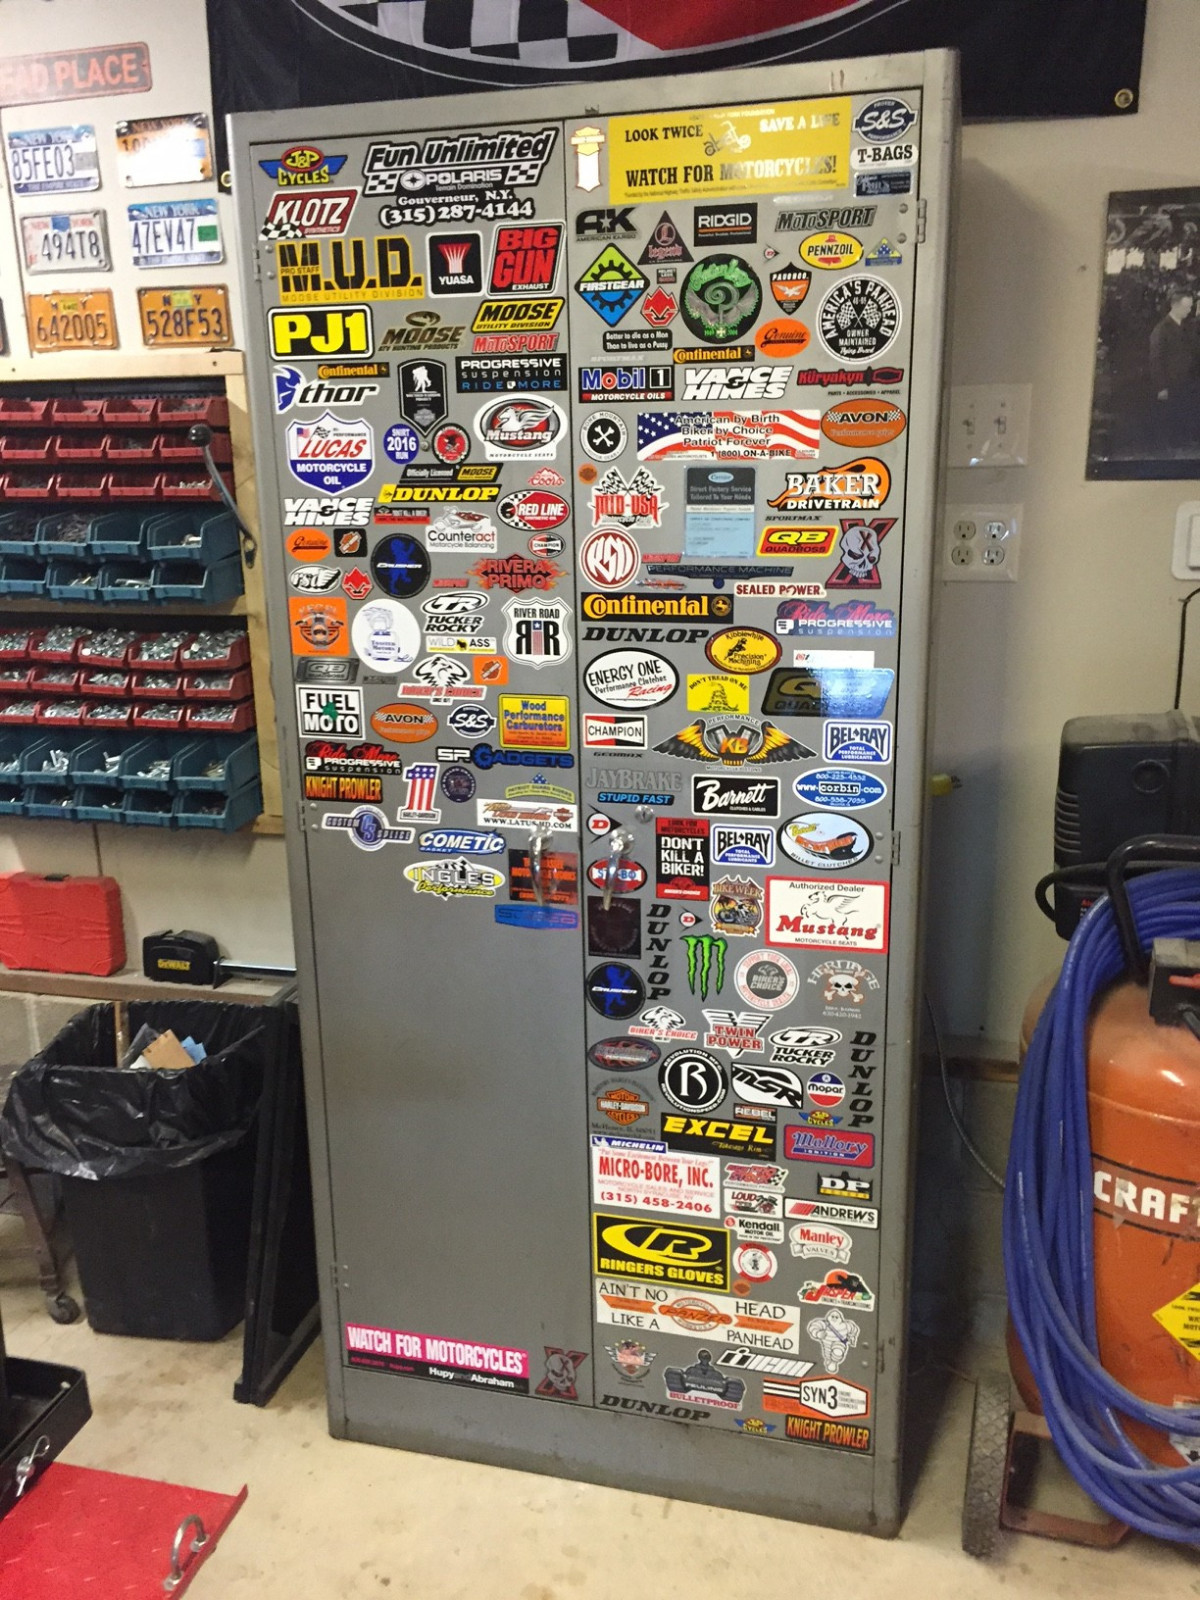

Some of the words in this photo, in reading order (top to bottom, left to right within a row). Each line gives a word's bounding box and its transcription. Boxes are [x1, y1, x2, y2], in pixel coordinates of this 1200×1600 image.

[54, 53, 138, 90] PLACE
[760, 117, 794, 132] SAVE
[861, 109, 907, 131] S&S
[625, 129, 659, 142] LOOK
[662, 125, 703, 139] TWICE
[368, 146, 416, 171] Fun
[424, 132, 552, 164] Unlimited
[858, 145, 913, 163] T-BAGS
[12, 144, 76, 181] 85FE03
[278, 165, 329, 186] CYCLES
[426, 169, 502, 185] POLARIS
[626, 167, 678, 187] WATCH
[684, 165, 714, 182] FOR
[719, 155, 837, 180] MOTORCYCLES!
[485, 190, 513, 201] N.Y.
[273, 197, 350, 226] KLOTZ
[698, 212, 752, 228] RIDGID
[132, 218, 195, 254] 47EV47
[498, 228, 558, 249] BIG
[42, 230, 100, 260] 494T8
[808, 244, 853, 257] PENNZOIL
[492, 249, 555, 288] GUN
[438, 275, 474, 286] YUASA
[512, 283, 549, 291] EXHAUST
[580, 280, 645, 292] FIRSTGEAR
[281, 294, 319, 302] MOOSE
[372, 288, 424, 299] DIVISION
[480, 303, 557, 322] MOOSE
[37, 314, 108, 342] 642005
[146, 307, 223, 337] 528F53
[476, 323, 508, 331] UTILITY
[510, 322, 551, 330] DIVISION
[274, 312, 367, 354] PJ1
[381, 326, 465, 345] MOOSE
[847, 329, 869, 338] OWNER
[839, 337, 876, 346] MAINTAINED
[674, 349, 741, 363] Continental
[318, 364, 378, 378] Continental
[461, 359, 561, 369] PROGRESSIVE
[462, 370, 561, 379] suspension
[582, 368, 645, 390] Mobil
[462, 381, 503, 390] RIDE
[518, 380, 561, 389] MORE
[299, 383, 377, 404] thor
[591, 393, 645, 401] MOTORCYCLE
[674, 415, 731, 425] American
[752, 413, 779, 423] Birth
[839, 412, 888, 423] AVON
[486, 429, 553, 444] Mustang
[682, 426, 713, 436] Biker
[733, 426, 772, 435] Choice
[298, 438, 367, 458] LUCAS
[387, 437, 417, 453] 2016
[683, 437, 722, 447] Patriot
[727, 437, 771, 446] Forever
[395, 451, 409, 461] RUN
[743, 449, 791, 458] ON-A-BIKE
[297, 463, 367, 473] MOTORCYCLE
[462, 468, 493, 476] MOOSE
[323, 476, 341, 485] OIL
[532, 476, 562, 487] Coors
[786, 473, 881, 497] BAKER
[393, 487, 499, 501] DUNLOP
[518, 503, 538, 516] RED
[541, 503, 565, 517] LINE
[786, 499, 880, 510] DRIVETRAIN
[428, 530, 495, 542] Counteract
[768, 530, 829, 545] QB
[465, 542, 494, 550] Balancing
[487, 559, 546, 574] RIVERA
[648, 564, 734, 574] PERFORMANCE
[738, 566, 791, 575] MACHINE
[489, 574, 545, 589] PRIMO
[736, 584, 775, 595] SEALED
[779, 585, 820, 595] POWER
[514, 607, 536, 619] RIVER
[539, 608, 560, 619] ROAD
[583, 594, 709, 619] Continental
[427, 616, 483, 624] TUCKER
[799, 619, 892, 628] PROGRESSIVE
[425, 624, 480, 633] ROCKY
[582, 627, 709, 644] DUNLOP
[428, 638, 456, 647] WILD
[469, 638, 490, 647] ASS
[588, 664, 634, 686] ENERGY
[638, 659, 662, 676] ONE
[627, 683, 673, 698] Racing
[306, 693, 355, 712] FUEL
[521, 700, 546, 711] Wood
[304, 714, 358, 733] MOTO
[385, 714, 423, 724] AVON
[454, 713, 488, 728] S&S
[504, 710, 564, 722] Performance
[506, 720, 562, 731] Carburetors
[588, 725, 642, 737] CHAMPION
[720, 737, 749, 754] KB
[324, 757, 400, 767] PROGRESSIVE
[586, 767, 682, 791] JAYBRAKE
[305, 776, 338, 799] KNIGHT
[340, 777, 381, 801] PROWLER
[696, 780, 776, 811] Barnett
[599, 793, 640, 803] STUPID
[642, 794, 671, 804] FAST
[421, 834, 504, 851] COMETIC
[661, 836, 704, 851] DON'T
[661, 850, 689, 863] KILL
[413, 868, 494, 886] INGLES
[661, 863, 704, 877] BIKER!
[418, 880, 495, 897] Performance
[713, 883, 733, 894] BIKE
[789, 881, 835, 893] Authorized
[837, 884, 865, 893] Dealer
[776, 915, 878, 940] Mustang
[795, 937, 837, 945] MOTORCYCLE
[646, 903, 672, 1000] DUNLOP
[715, 1025, 755, 1037] TWIN
[707, 1035, 762, 1049] POWER
[775, 1047, 833, 1058] TUCKER
[772, 1055, 830, 1066] ROCKY
[848, 1031, 877, 1128] DUNLOP
[808, 1084, 843, 1094] mopar
[664, 1116, 773, 1144] EXCEL
[611, 1140, 664, 1151] MICHELIN
[793, 1132, 867, 1154] Mallory
[804, 1149, 844, 1157] IGNITION
[599, 1156, 683, 1187] MICRO-BORE,
[687, 1166, 713, 1188] INC.
[601, 1191, 637, 1205] (315)
[642, 1196, 712, 1213] 458-2406
[732, 1192, 756, 1201] LOUD
[813, 1205, 875, 1222] ANDREWS
[739, 1217, 781, 1232] Kendall
[800, 1228, 844, 1248] Manley
[600, 1258, 664, 1277] RINGERS
[668, 1267, 724, 1285] GLOVES
[599, 1282, 642, 1300] AIN'T
[646, 1289, 668, 1302] NO
[666, 1307, 727, 1324] PANZER
[735, 1301, 786, 1319] HEAD
[612, 1313, 644, 1327] LIKE
[649, 1318, 660, 1330] A
[727, 1330, 793, 1350] PANHEAD
[347, 1326, 391, 1354] WATCH
[396, 1334, 422, 1358] FOR
[425, 1339, 523, 1374] MOTORCYCLES
[429, 1366, 454, 1380] Hupy
[470, 1373, 514, 1388] Abraham
[600, 1394, 711, 1420] DUNLOP
[787, 1416, 821, 1441] KNIGHT
[823, 1422, 869, 1449] PROWLER
